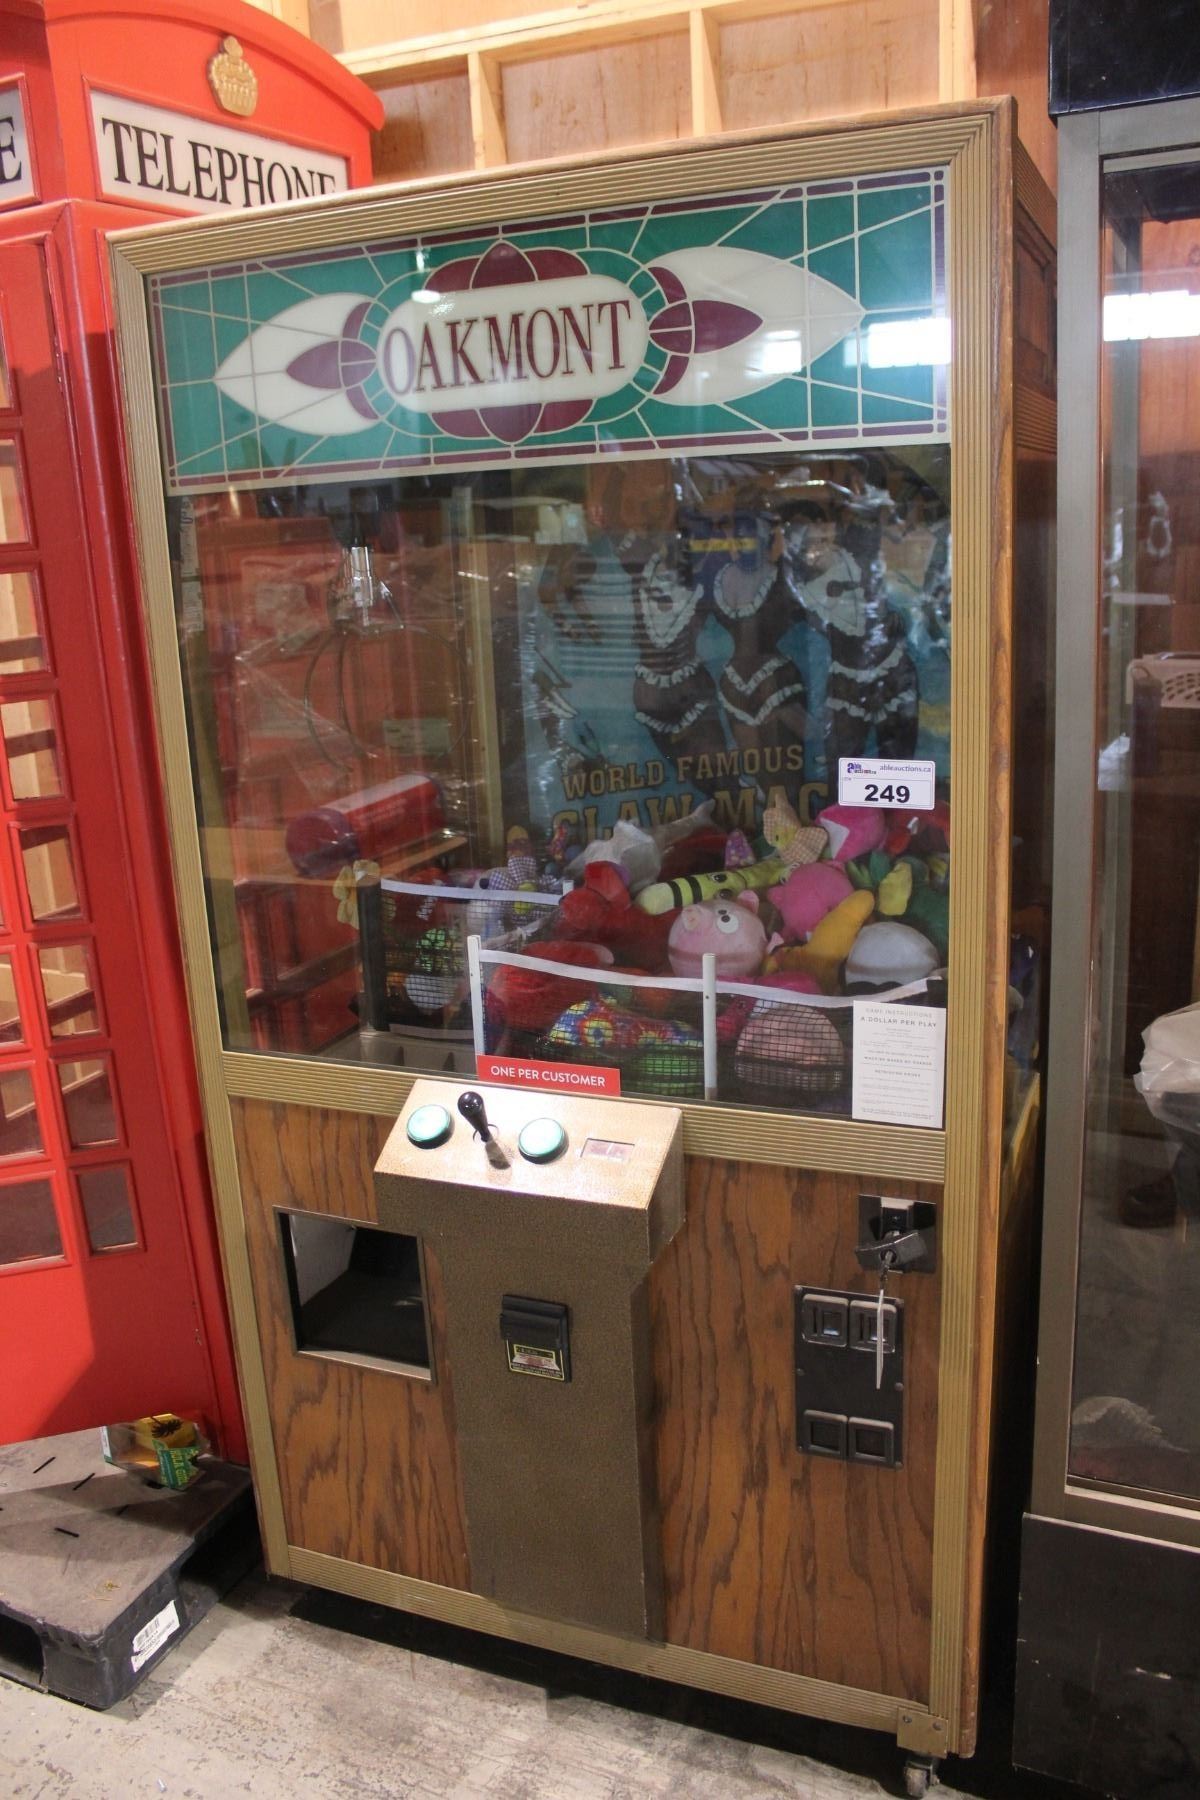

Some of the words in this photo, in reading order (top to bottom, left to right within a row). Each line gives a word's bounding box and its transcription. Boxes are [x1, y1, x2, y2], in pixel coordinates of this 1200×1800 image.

[382, 299, 631, 396] OAKMONT
[562, 760, 664, 800] WORLD
[676, 744, 804, 783] FAMOUS
[864, 784, 911, 804] 249
[868, 1016, 897, 1024] DOLLAR
[490, 1065, 515, 1078] ONE
[518, 1068, 539, 1080] PER
[541, 1071, 605, 1087] CUSTOMER
